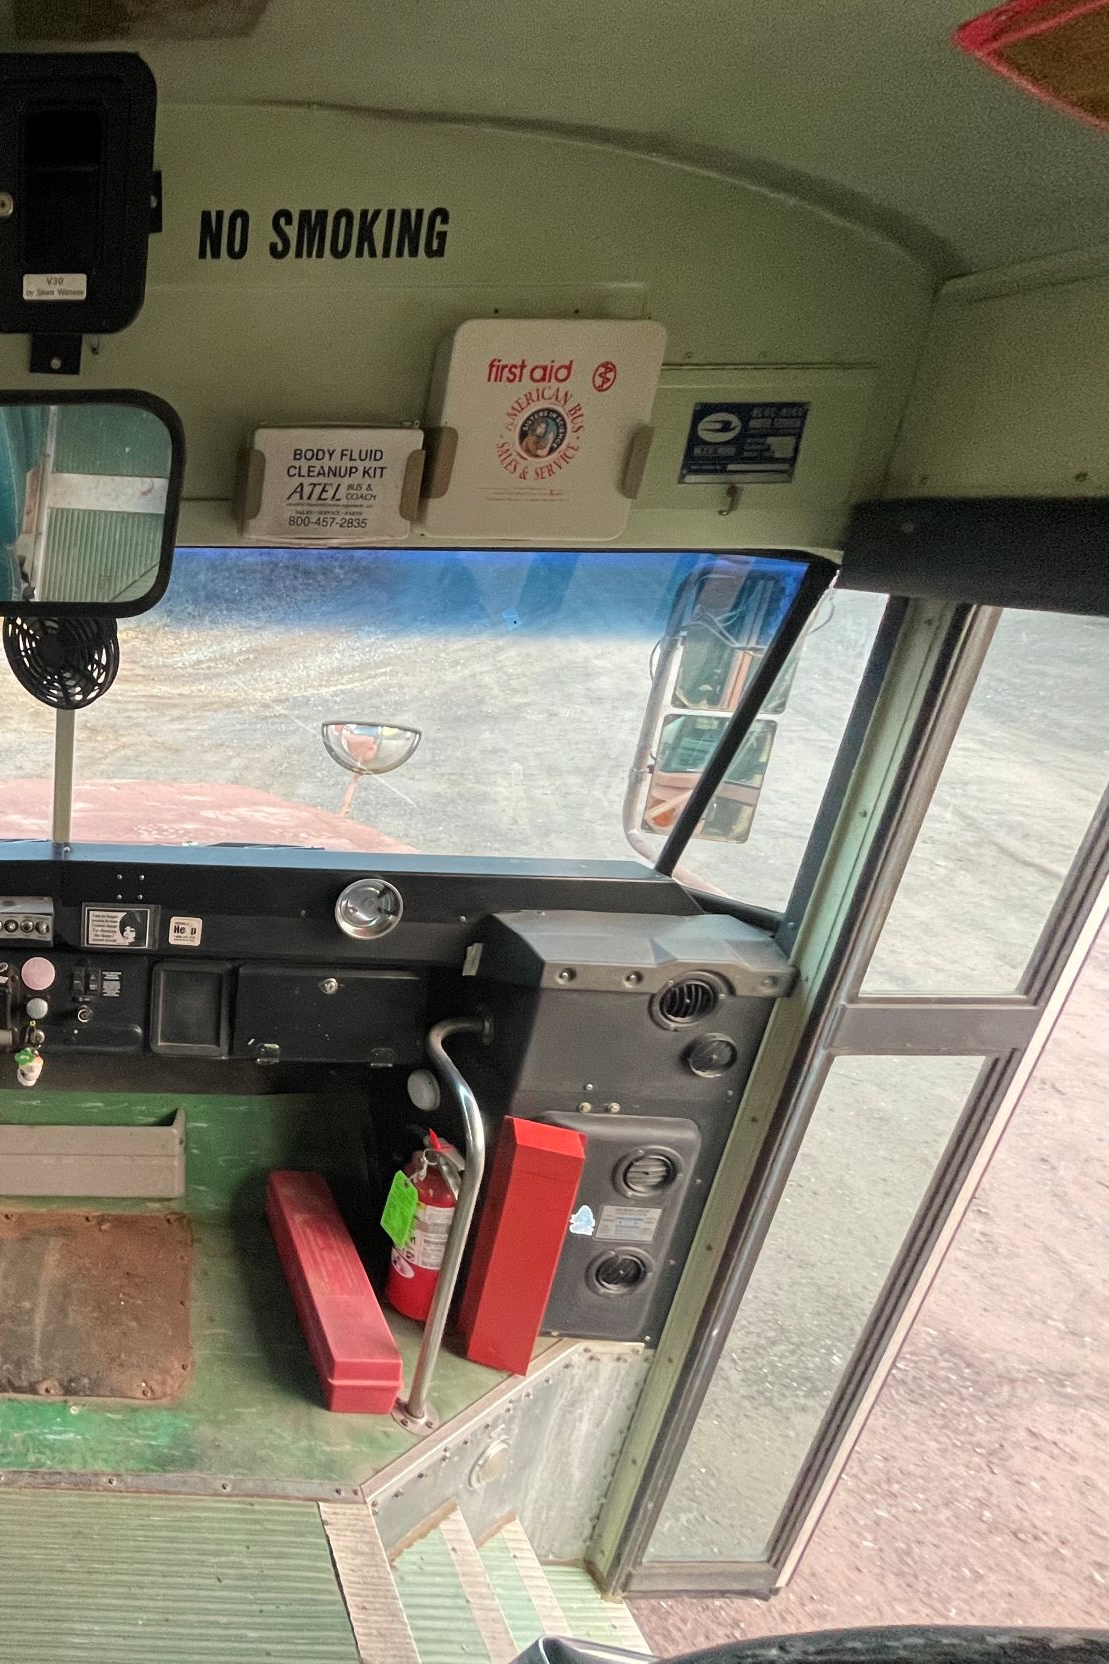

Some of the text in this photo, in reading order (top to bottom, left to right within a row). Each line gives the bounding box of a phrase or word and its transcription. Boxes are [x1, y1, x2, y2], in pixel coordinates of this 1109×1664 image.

[198, 207, 450, 260] NO SMOKING
[487, 358, 574, 383] first aid
[568, 403, 585, 433] BUS
[293, 448, 384, 462] BODY FLUID
[496, 441, 520, 474] SALES
[534, 443, 580, 480] SERVICE
[286, 465, 387, 479] CLEANUP KIT
[285, 482, 341, 501] ATEL
[346, 483, 363, 491] BUS
[287, 515, 368, 529] 800-457-2835
